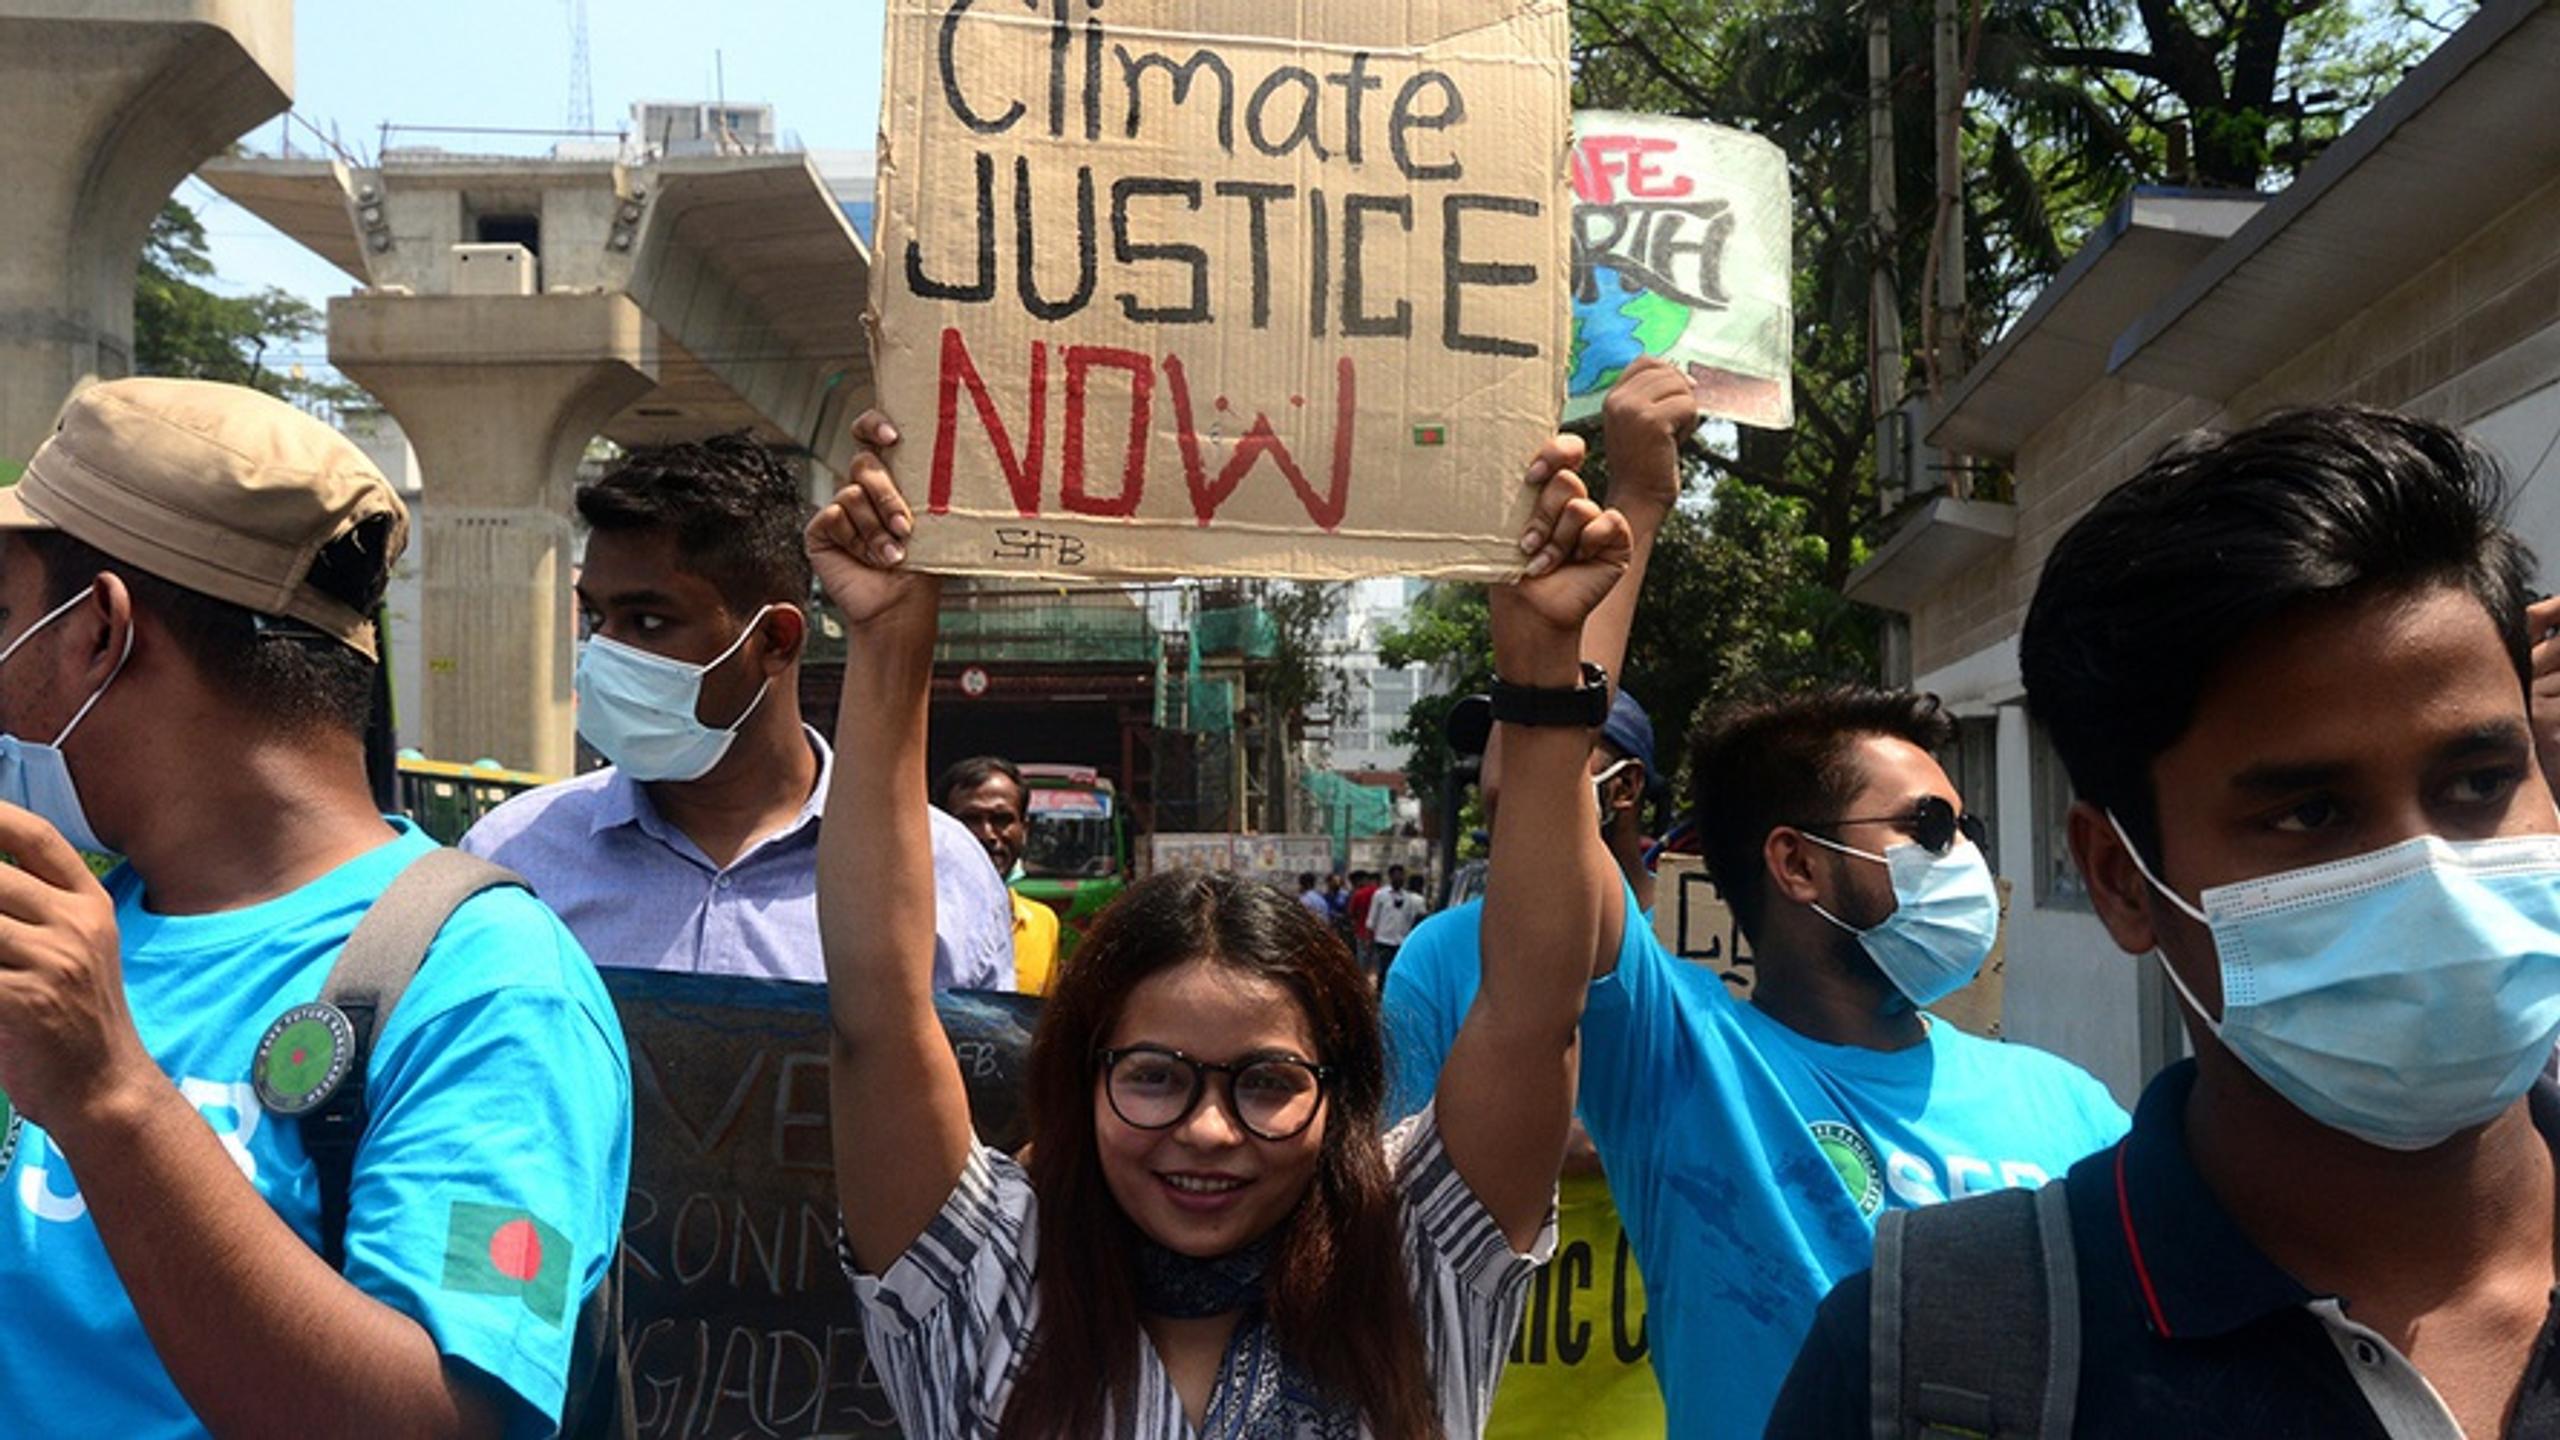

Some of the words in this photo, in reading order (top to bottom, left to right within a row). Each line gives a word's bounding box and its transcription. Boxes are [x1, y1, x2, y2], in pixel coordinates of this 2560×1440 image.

[937, 0, 1466, 181] Climate
[905, 151, 1540, 359] JUSTICE
[1571, 199, 1735, 311] RTH
[926, 327, 1355, 533] NOW
[992, 526, 1086, 566] SFB
